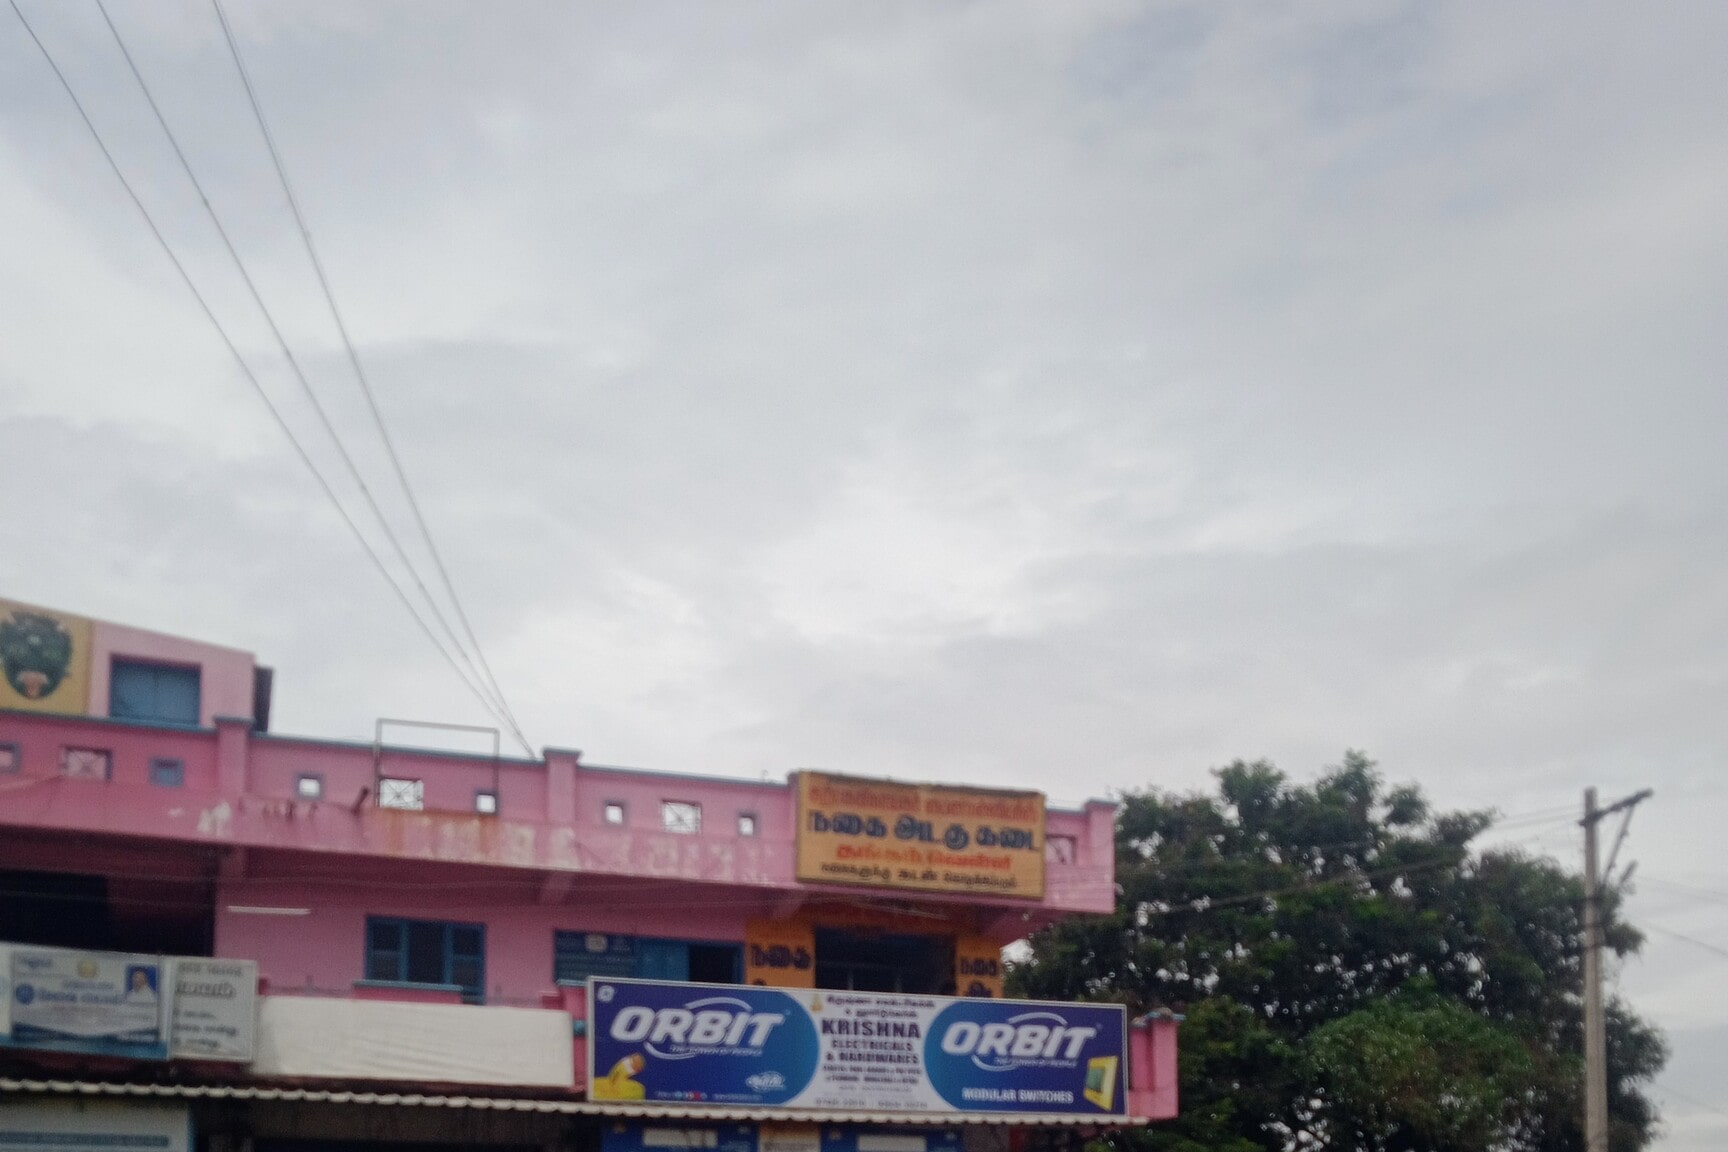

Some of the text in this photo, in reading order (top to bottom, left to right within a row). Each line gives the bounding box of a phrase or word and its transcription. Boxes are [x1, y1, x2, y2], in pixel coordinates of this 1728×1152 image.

[808, 810, 1039, 851] நகை அடகு கடை
[610, 1006, 785, 1047] ORBIT
[822, 1020, 920, 1038] KRISHNA
[942, 1022, 1097, 1058] ORBIT
[962, 1087, 1074, 1105] MODULAR SWITCHES
